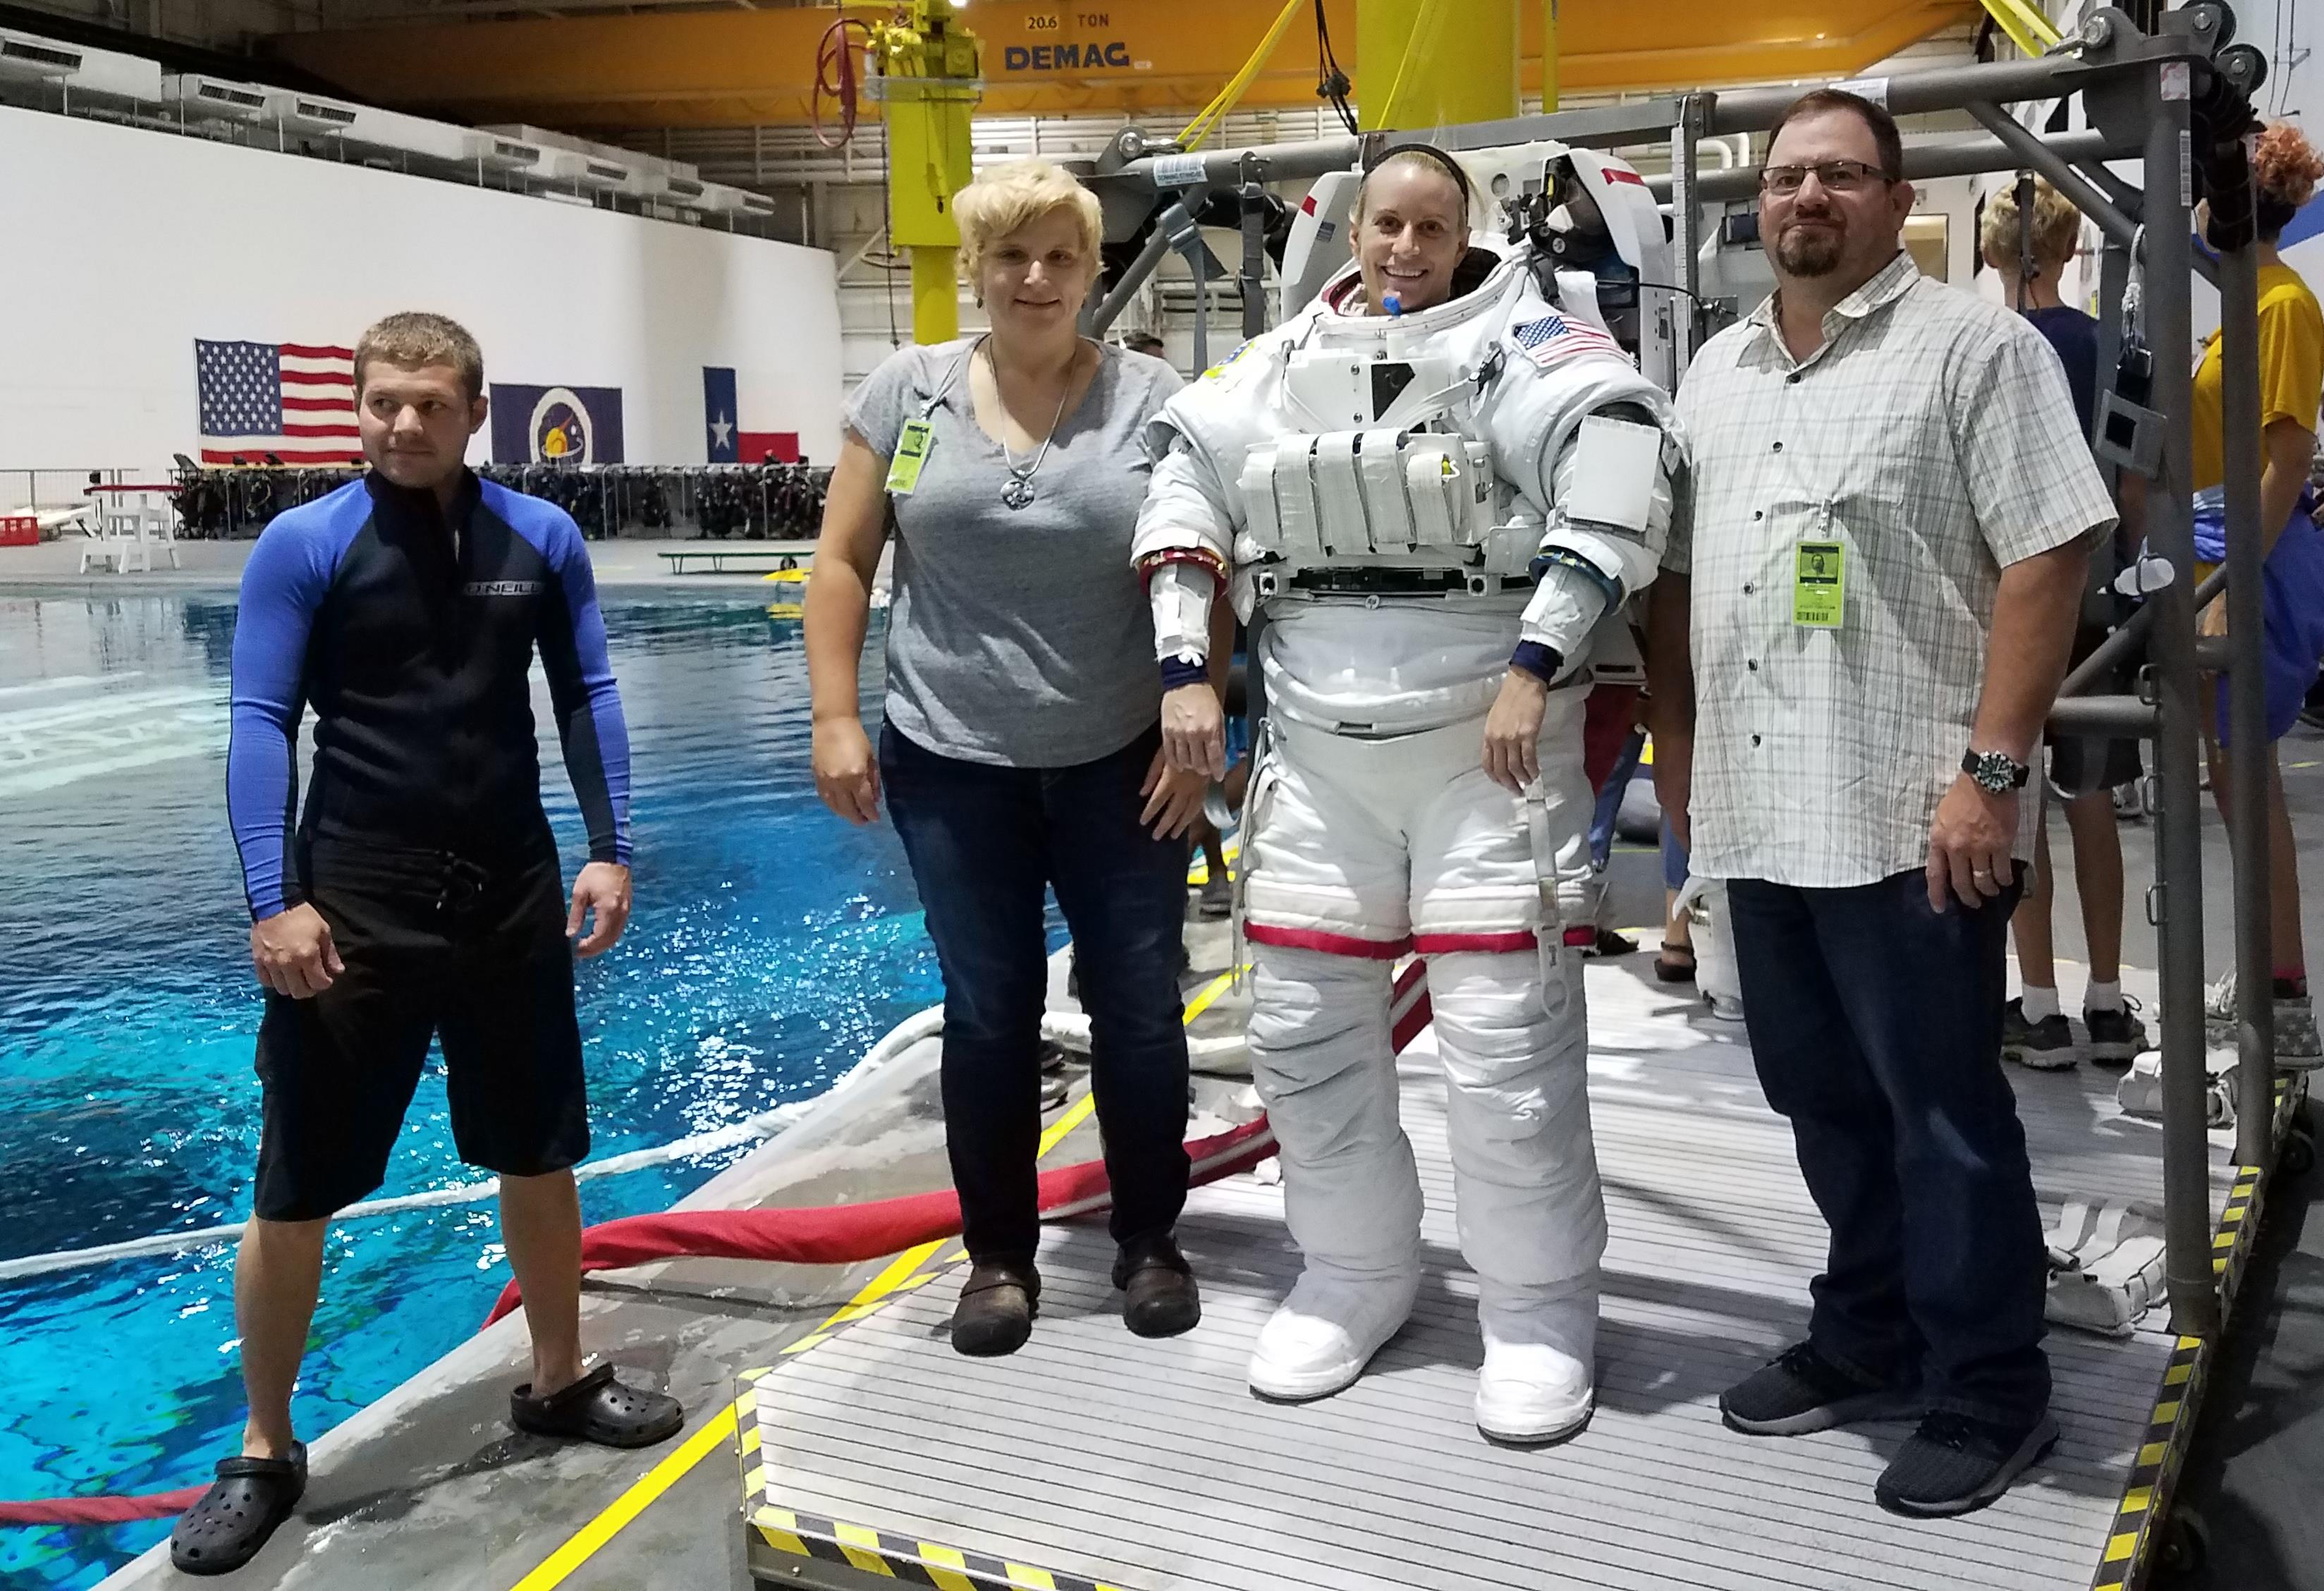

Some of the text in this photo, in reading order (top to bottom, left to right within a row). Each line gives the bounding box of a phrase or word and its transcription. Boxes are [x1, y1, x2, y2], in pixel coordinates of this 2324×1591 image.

[1028, 14, 1109, 29] 20.6 TON
[1005, 42, 1130, 70] DEMAG
